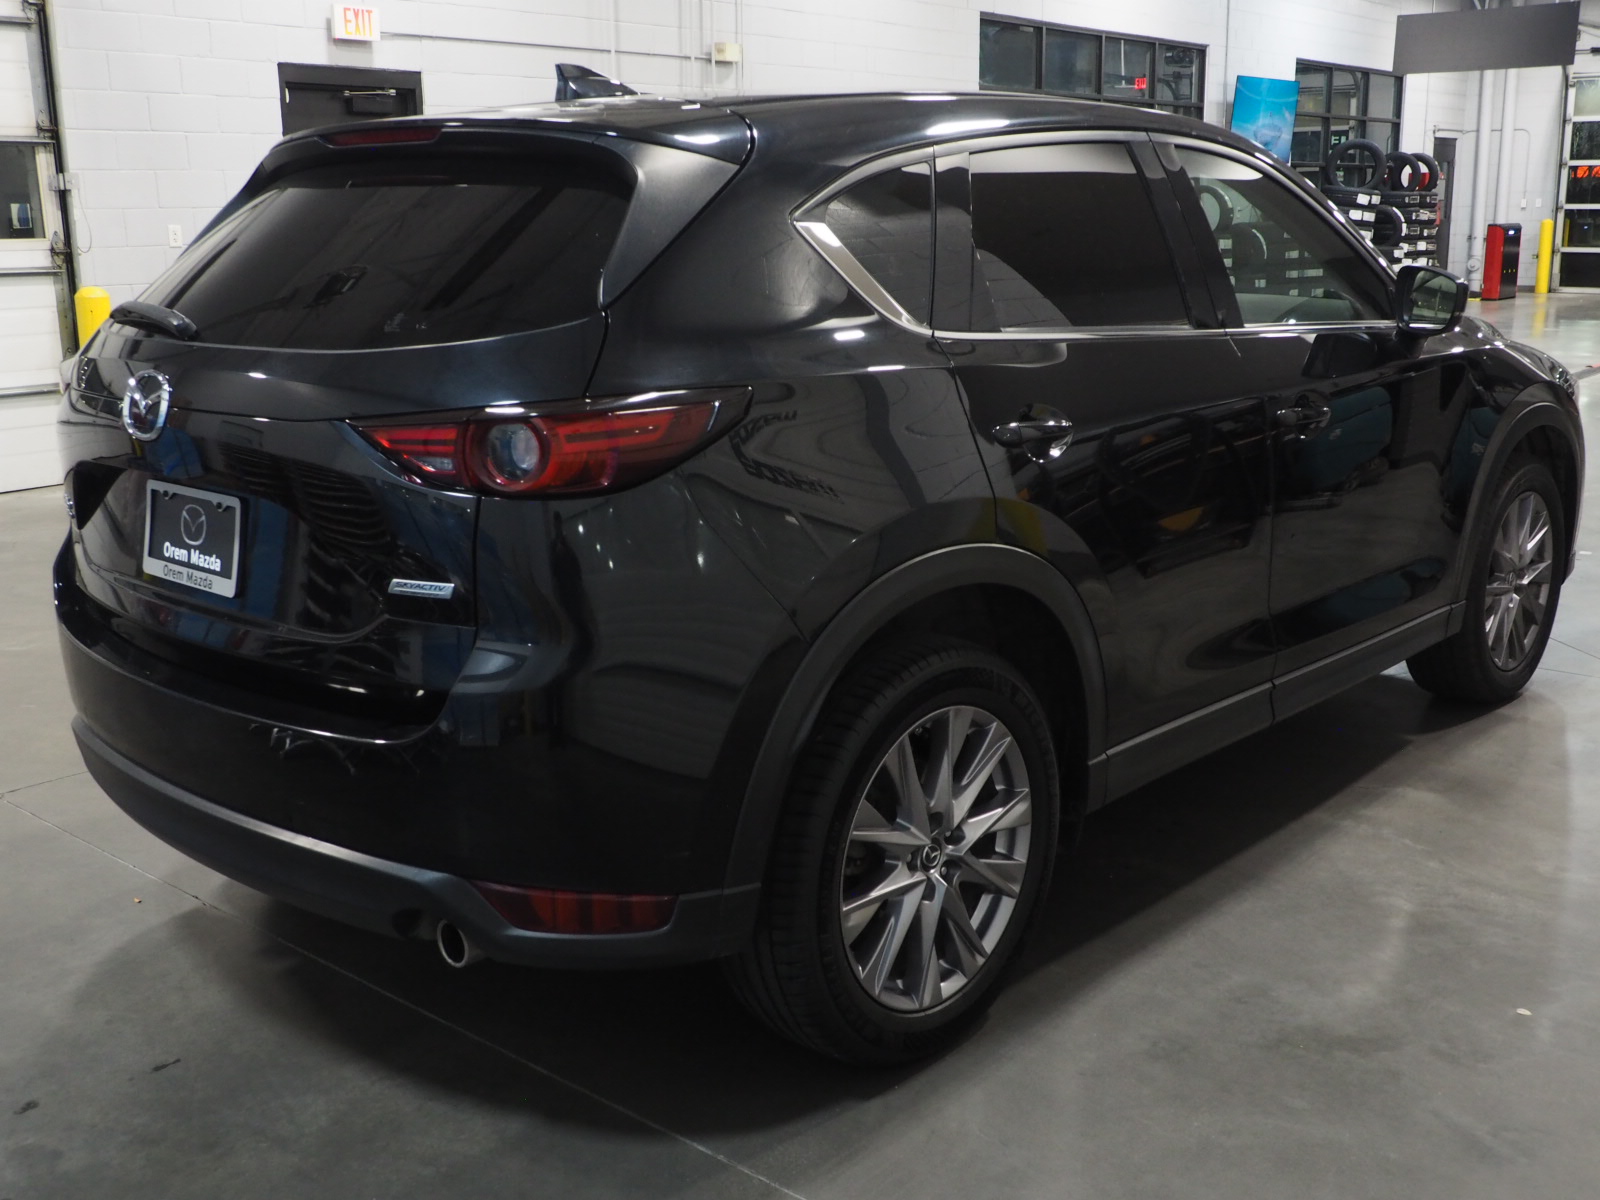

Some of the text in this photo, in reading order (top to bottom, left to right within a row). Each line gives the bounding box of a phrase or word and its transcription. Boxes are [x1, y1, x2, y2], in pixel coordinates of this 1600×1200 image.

[343, 7, 373, 37] EXIT
[163, 541, 222, 572] Orem Mazda
[163, 564, 213, 590] Orem Mazda
[395, 581, 447, 592] SKYACTIV
